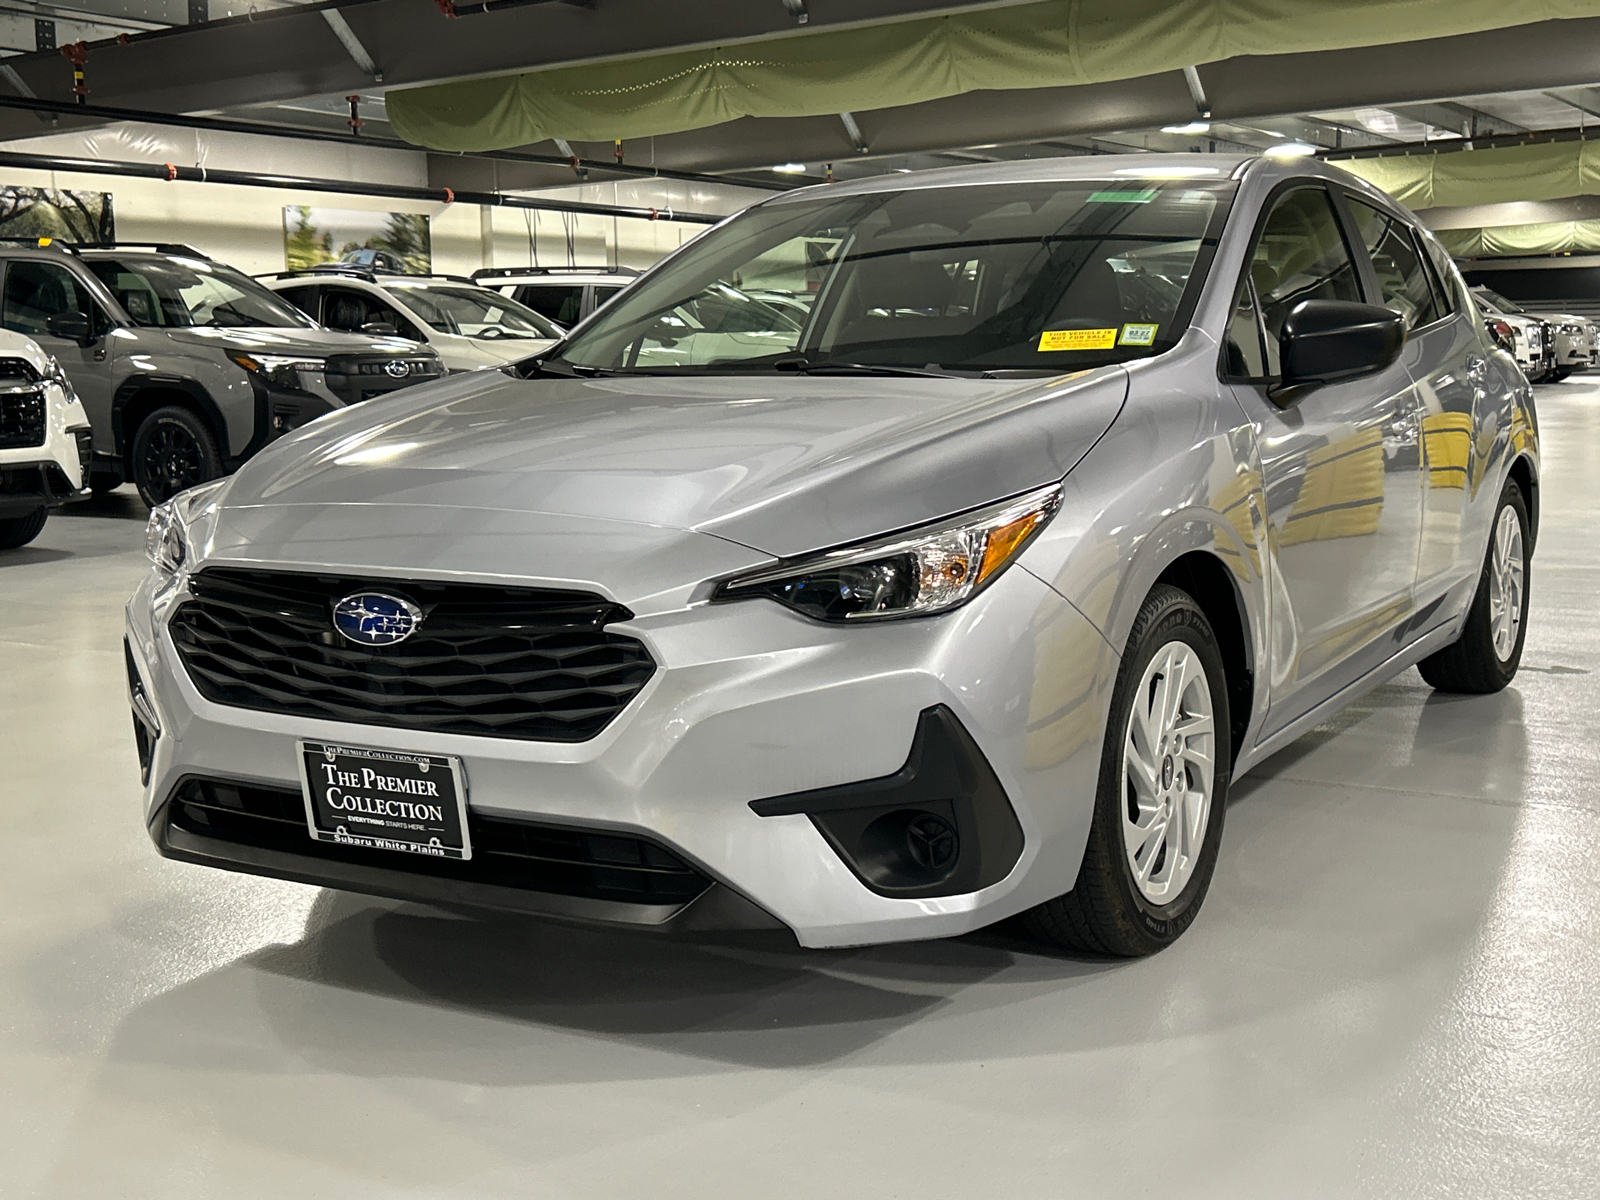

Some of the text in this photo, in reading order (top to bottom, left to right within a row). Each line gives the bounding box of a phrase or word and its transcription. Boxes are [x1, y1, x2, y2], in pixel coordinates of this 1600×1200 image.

[321, 763, 440, 797] THE PREMIER
[326, 786, 443, 822] COLLECTION
[347, 815, 385, 826] EVERYTHING
[385, 820, 408, 830] STARTS
[334, 834, 445, 856] Subaru White Plains
